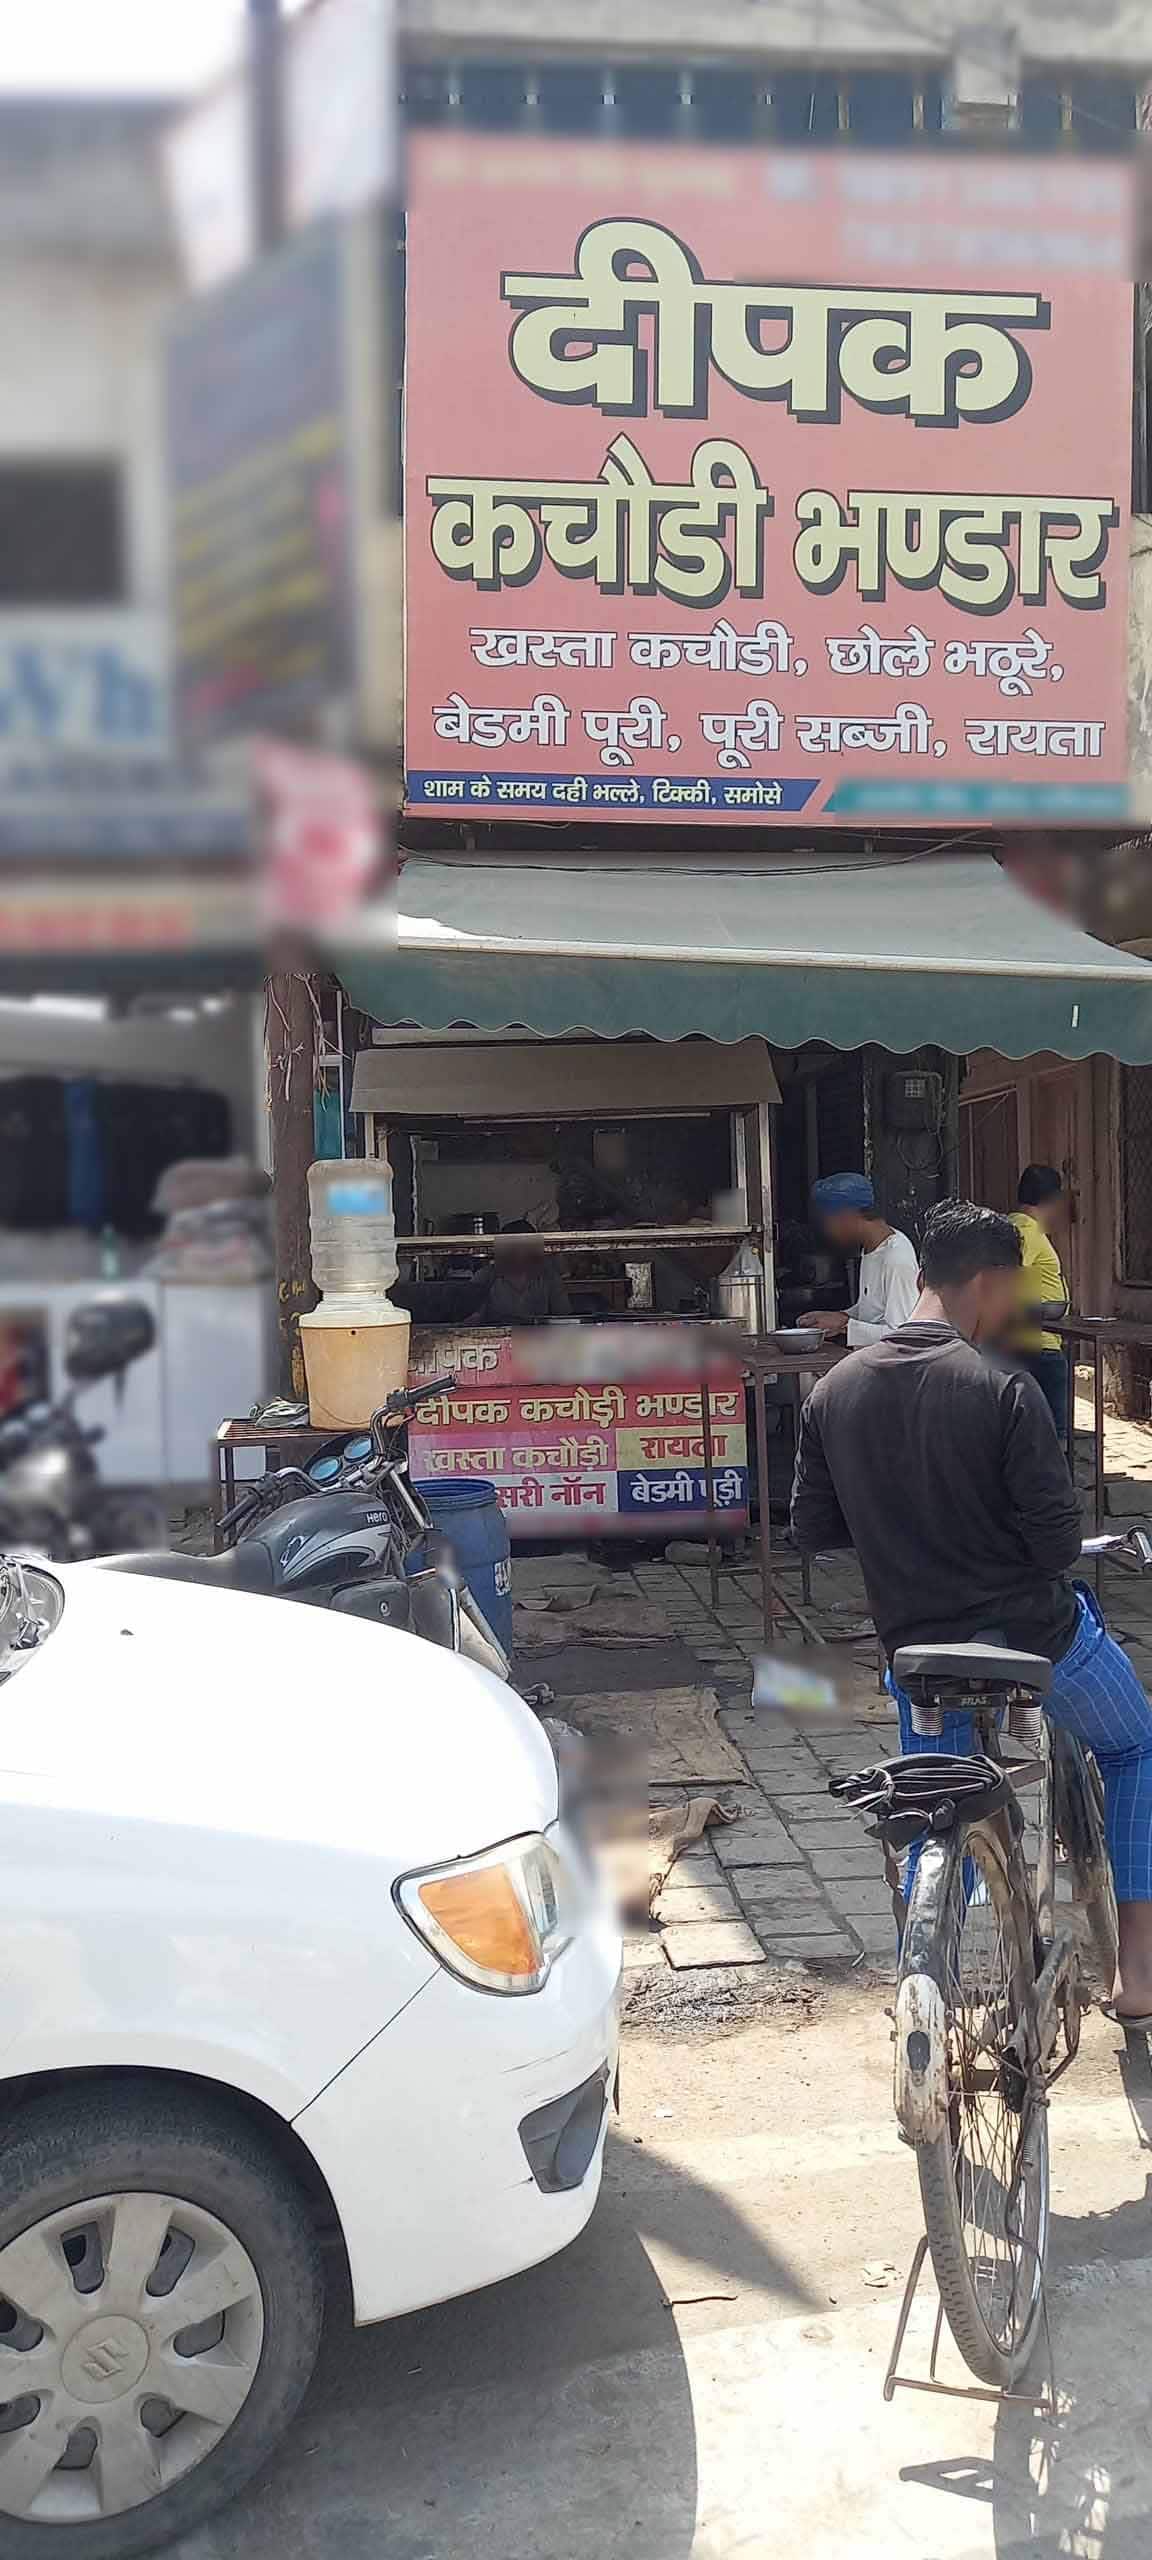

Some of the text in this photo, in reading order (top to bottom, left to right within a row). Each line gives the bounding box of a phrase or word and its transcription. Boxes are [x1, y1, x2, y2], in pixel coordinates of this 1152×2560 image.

[500, 216, 1050, 428] दीपक
[425, 432, 774, 608] कचौडी
[793, 488, 1120, 616] भण्डार
[469, 627, 616, 669] खस्ता
[826, 625, 934, 677] छोले
[943, 628, 1064, 697] भठूरे,
[432, 693, 1105, 769] बेडमी पूरी, पूरी सब्जी, रायता
[423, 774, 783, 806] शाम के समय दही भल्ले, टिक्की, समोसे
[635, 1391, 739, 1419] भण्डार
[549, 1475, 606, 1507] नॉन
[630, 1471, 694, 1504] बेडमी
[366, 1511, 388, 1523] Hero
